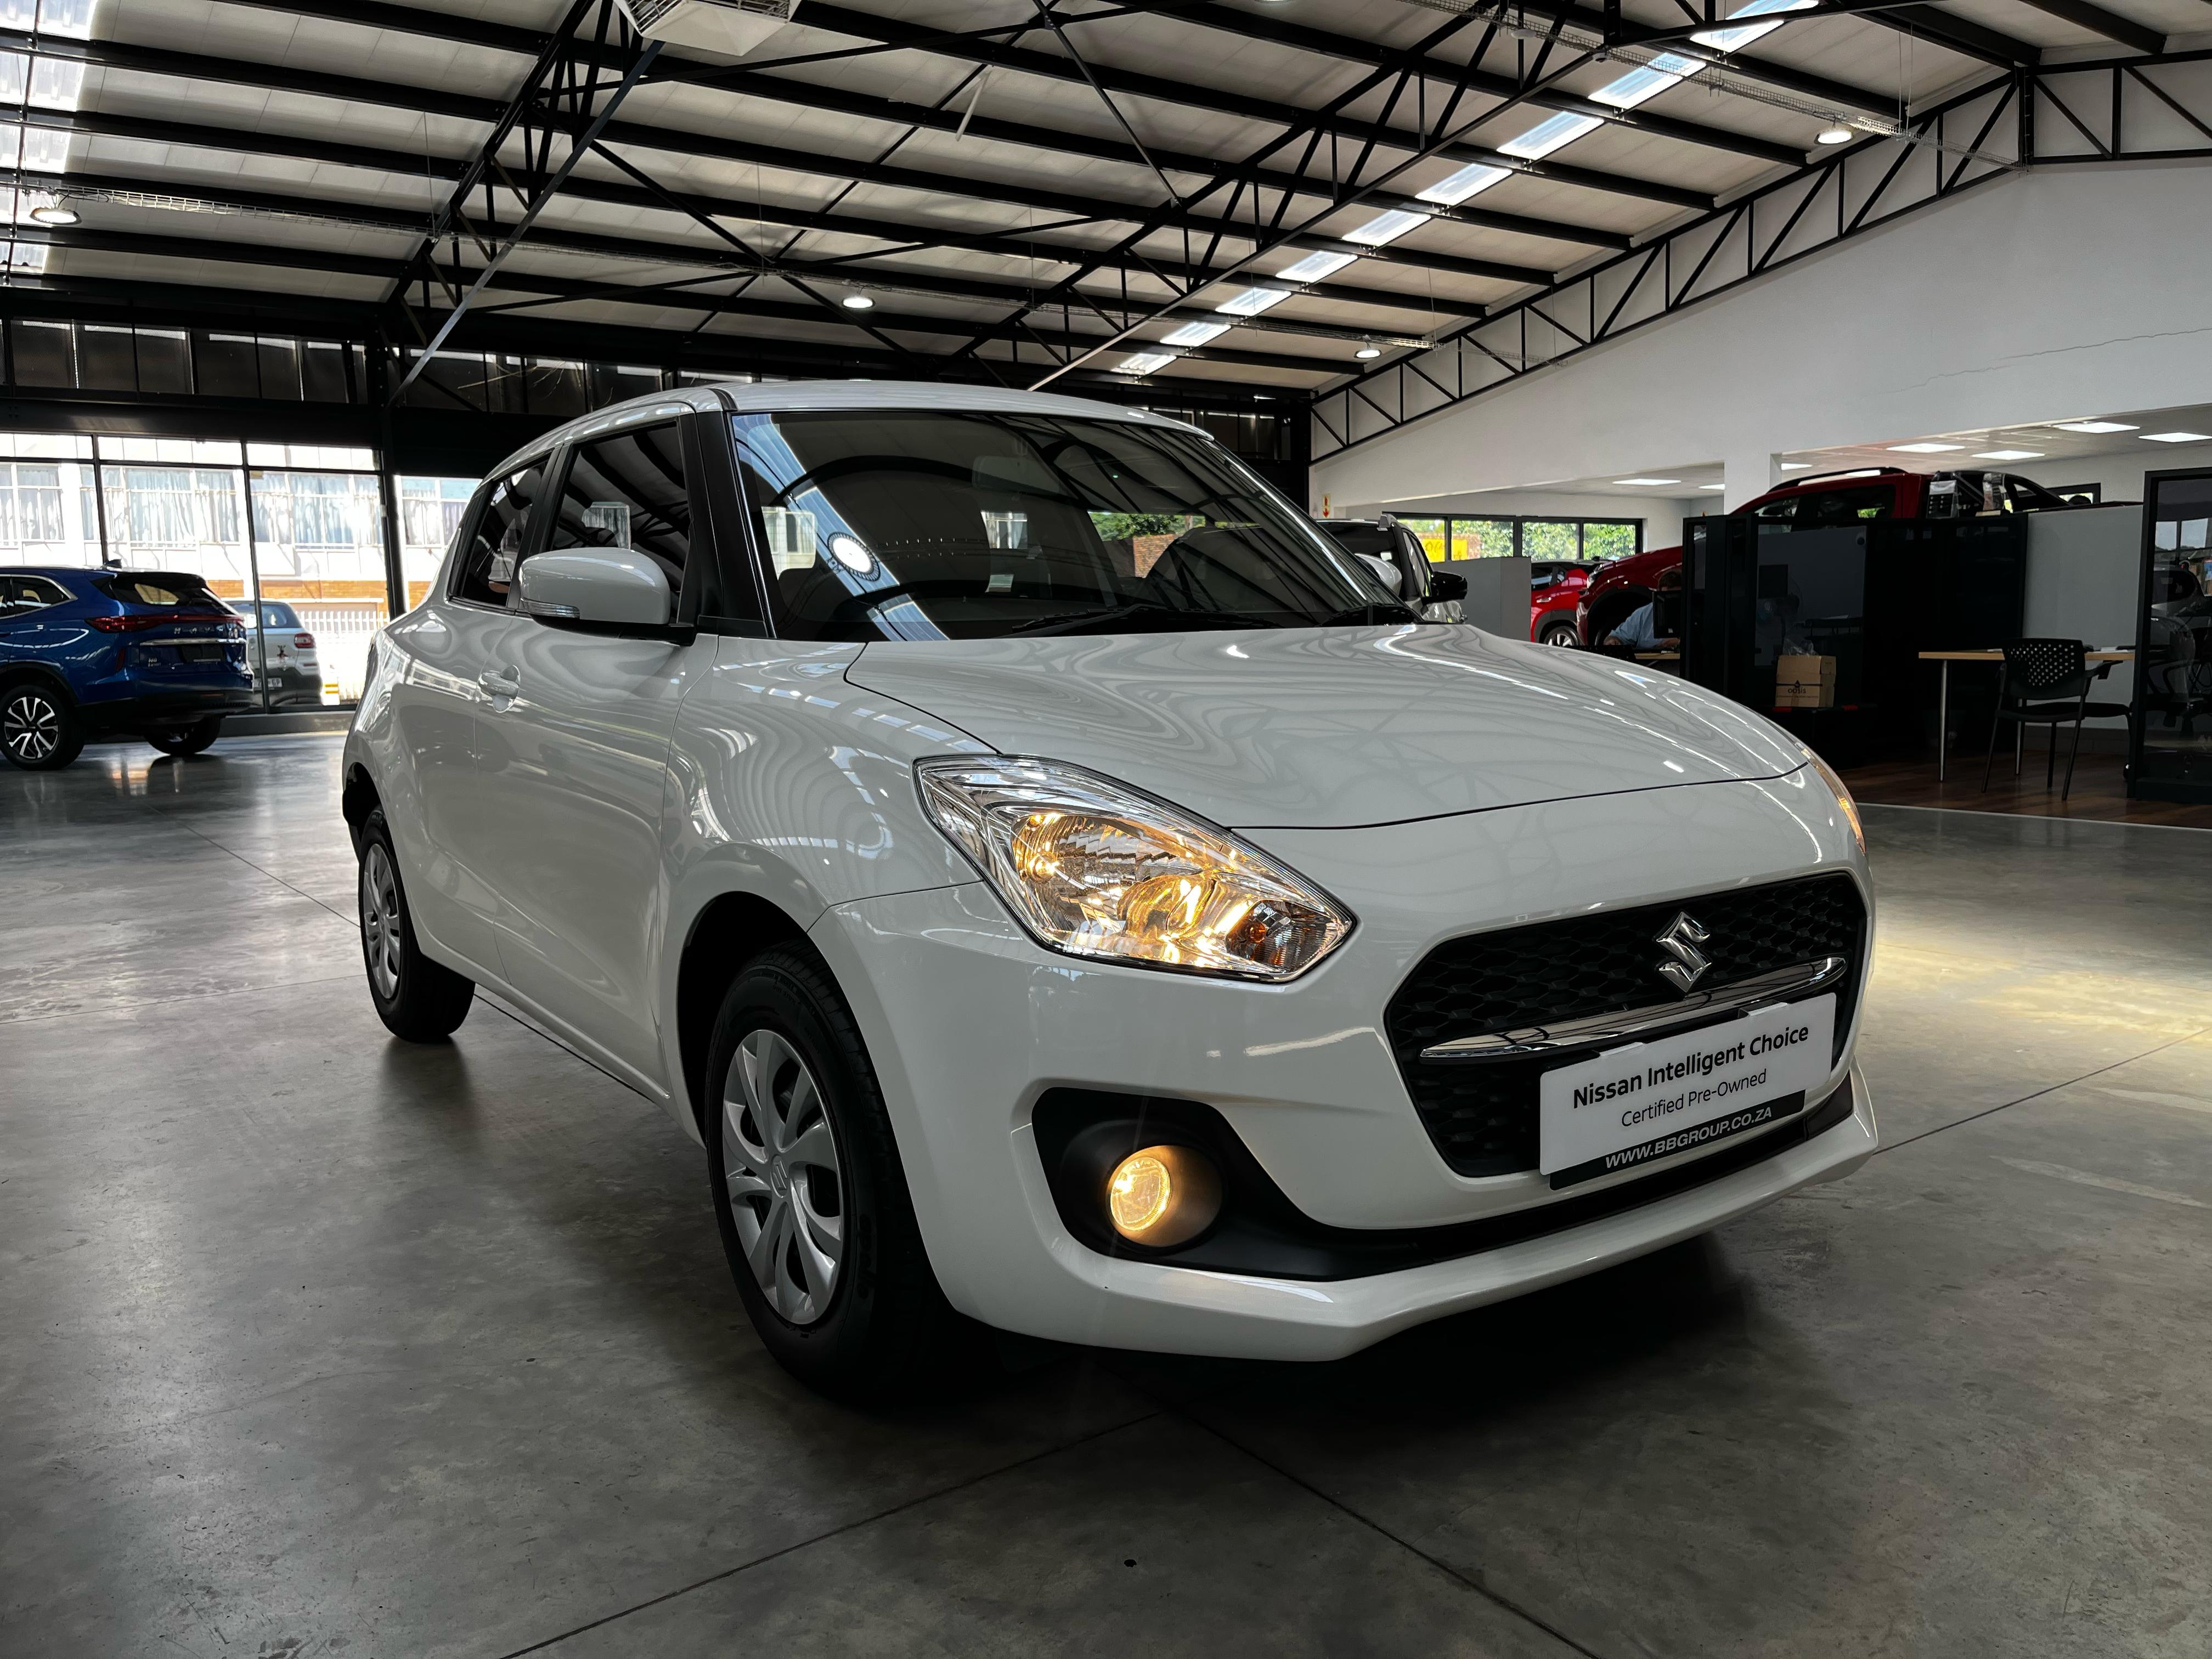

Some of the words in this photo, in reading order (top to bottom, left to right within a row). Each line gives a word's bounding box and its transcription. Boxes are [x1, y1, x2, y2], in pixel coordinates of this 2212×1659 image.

[1573, 1075, 1642, 1109] Nissan
[1648, 1042, 1745, 1087] Intelligent
[1750, 1026, 1809, 1056] Choice
[1622, 1093, 1684, 1127] Certified
[1688, 1068, 1767, 1107] Pre-Owned
[1605, 1107, 1773, 1169] WWW.BBGROUP.CO.ZA
